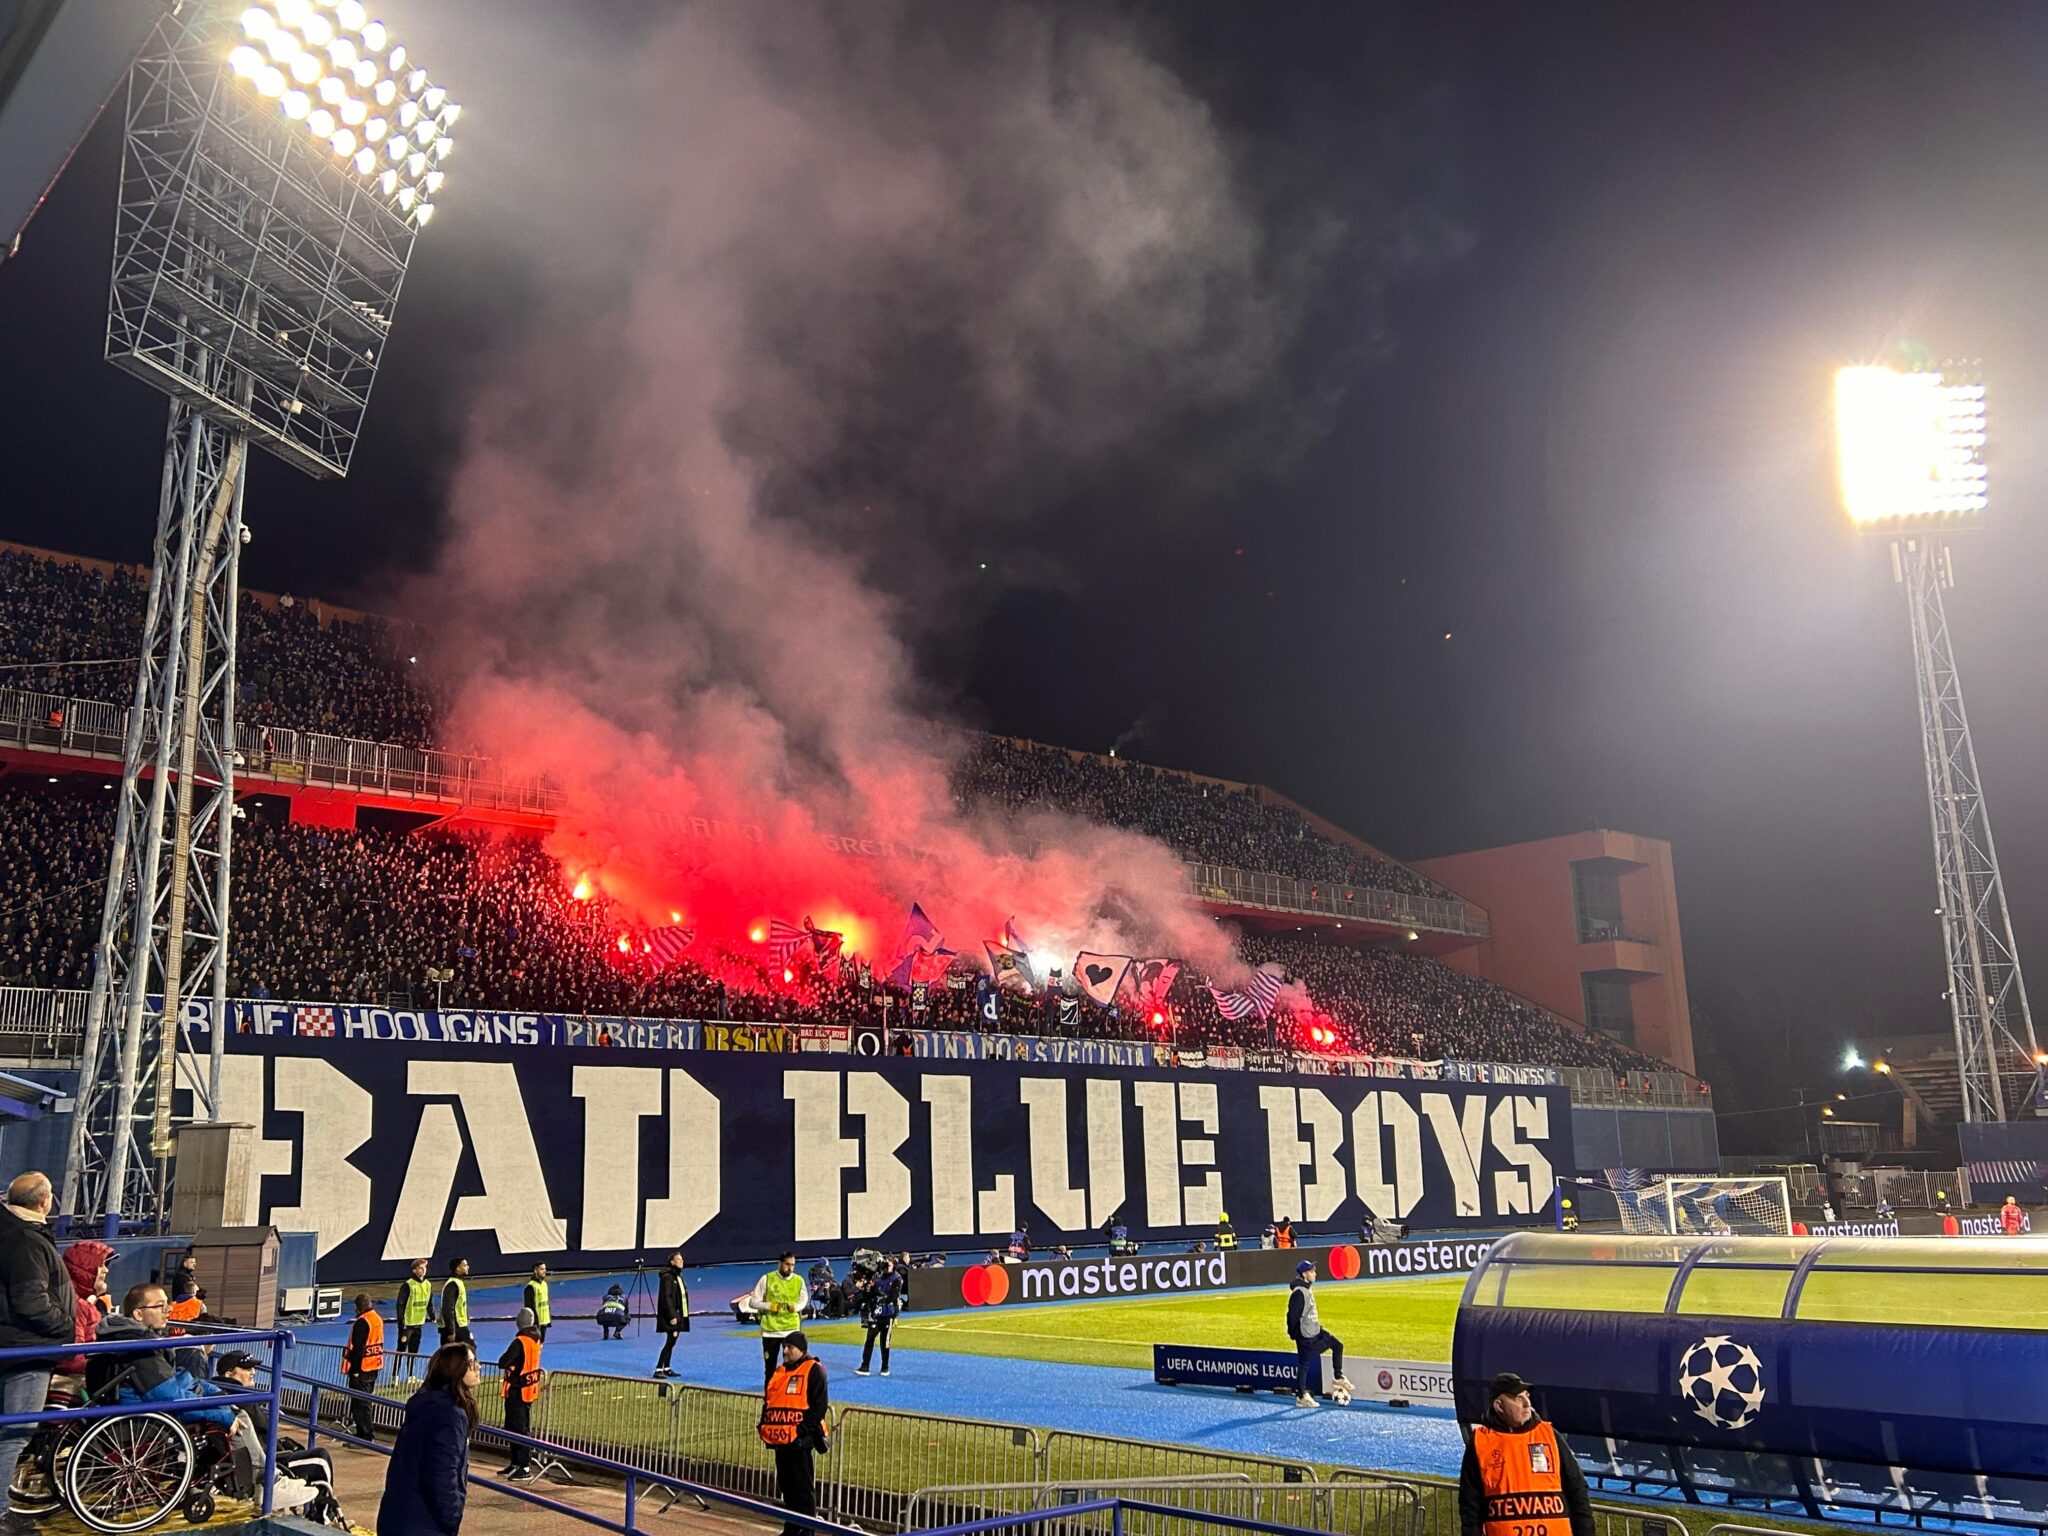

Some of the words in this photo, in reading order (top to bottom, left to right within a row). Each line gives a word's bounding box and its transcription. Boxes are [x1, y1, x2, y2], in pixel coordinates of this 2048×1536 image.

[347, 1008, 539, 1045] HOOLIGANS
[801, 1029, 813, 1037] BAD
[831, 1030, 847, 1039] BOYS
[914, 1032, 1011, 1060] DINAMO
[1458, 1063, 1490, 1083] BLUE
[175, 1053, 721, 1262] BAD
[783, 1069, 1220, 1242] BLUE
[1259, 1086, 1553, 1222] BOYS
[1812, 1218, 1899, 1236] mastercard
[1961, 1213, 2031, 1235] masted
[1022, 1251, 1227, 1298] mastercard
[1167, 1357, 1194, 1372] UEFA
[1196, 1359, 1259, 1376] CHAMPIONS
[1262, 1364, 1298, 1380] LEAGU
[1400, 1373, 1455, 1394] RESPEC
[767, 1428, 788, 1441] 250
[1488, 1496, 1565, 1517] STEWARD
